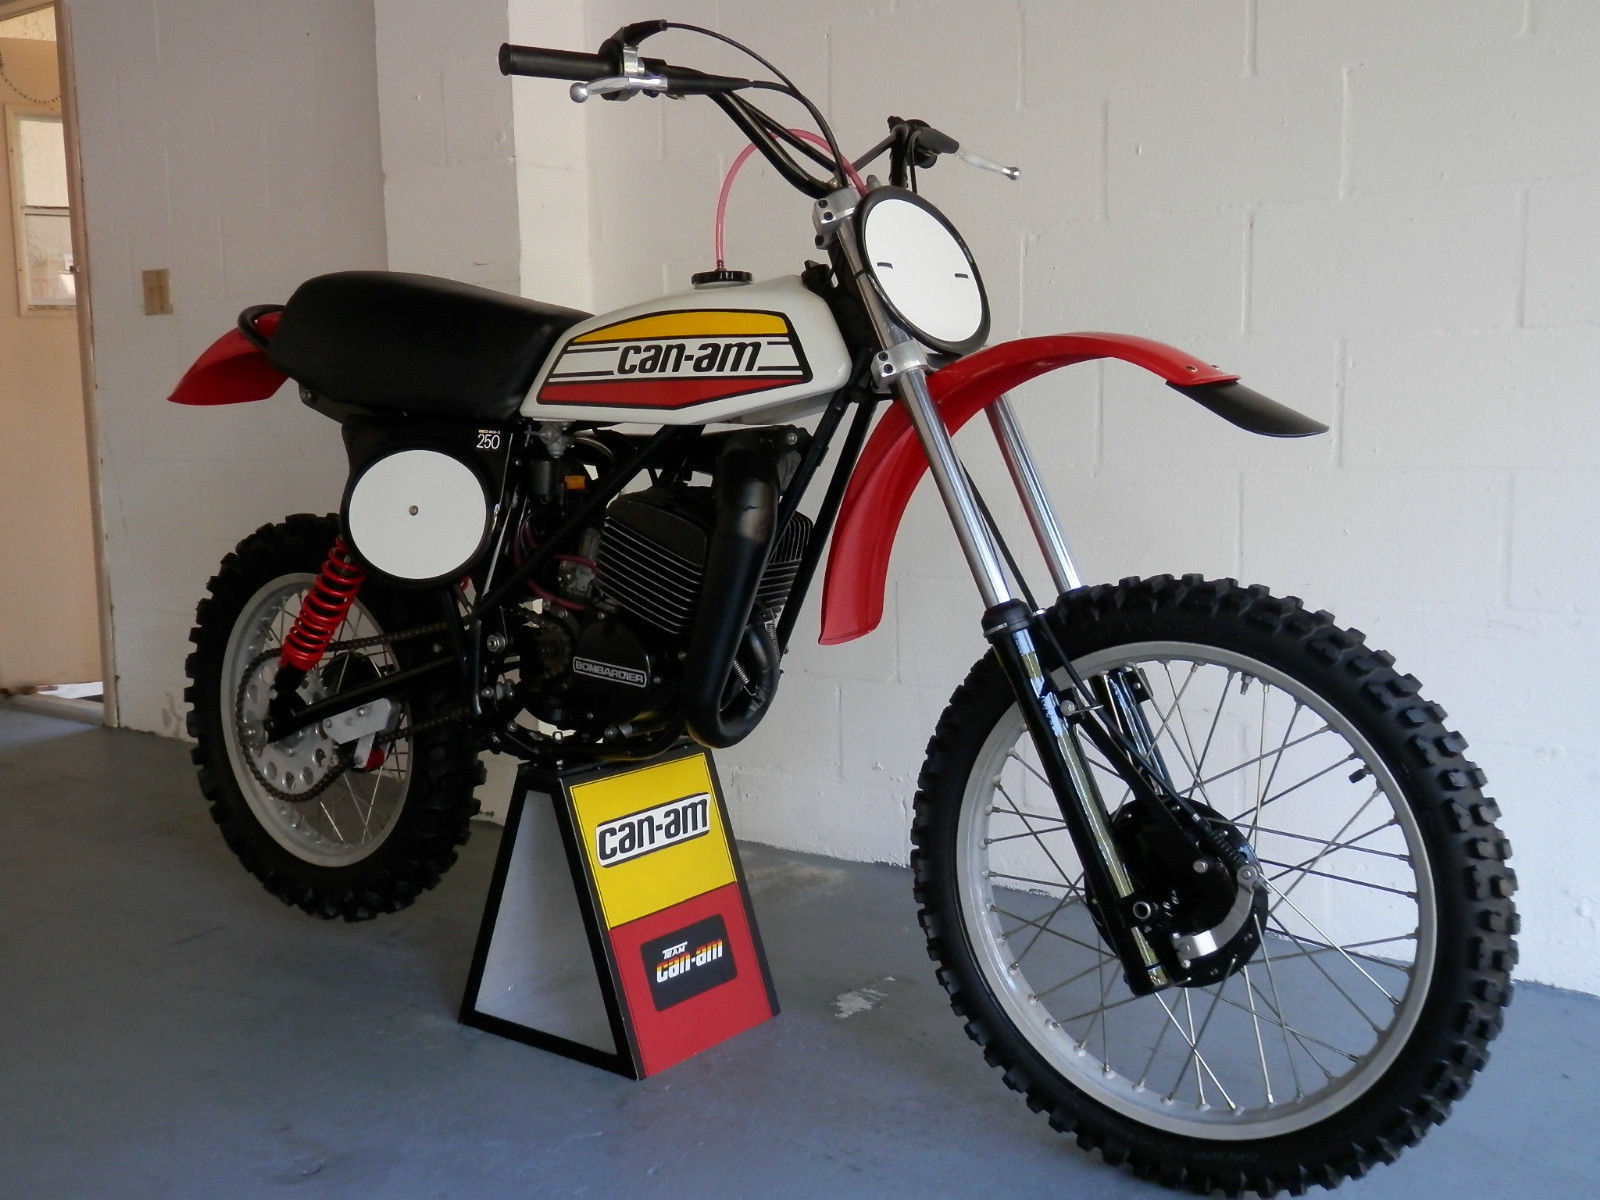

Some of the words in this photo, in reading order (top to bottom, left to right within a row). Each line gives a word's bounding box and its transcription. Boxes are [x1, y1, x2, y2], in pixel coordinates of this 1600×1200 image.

[617, 341, 762, 375] can-am
[476, 433, 501, 450] 250
[575, 660, 644, 683] BOMBARDIER
[598, 798, 708, 861] can-am
[656, 938, 723, 983] can-am
[662, 941, 688, 960] TEAM
